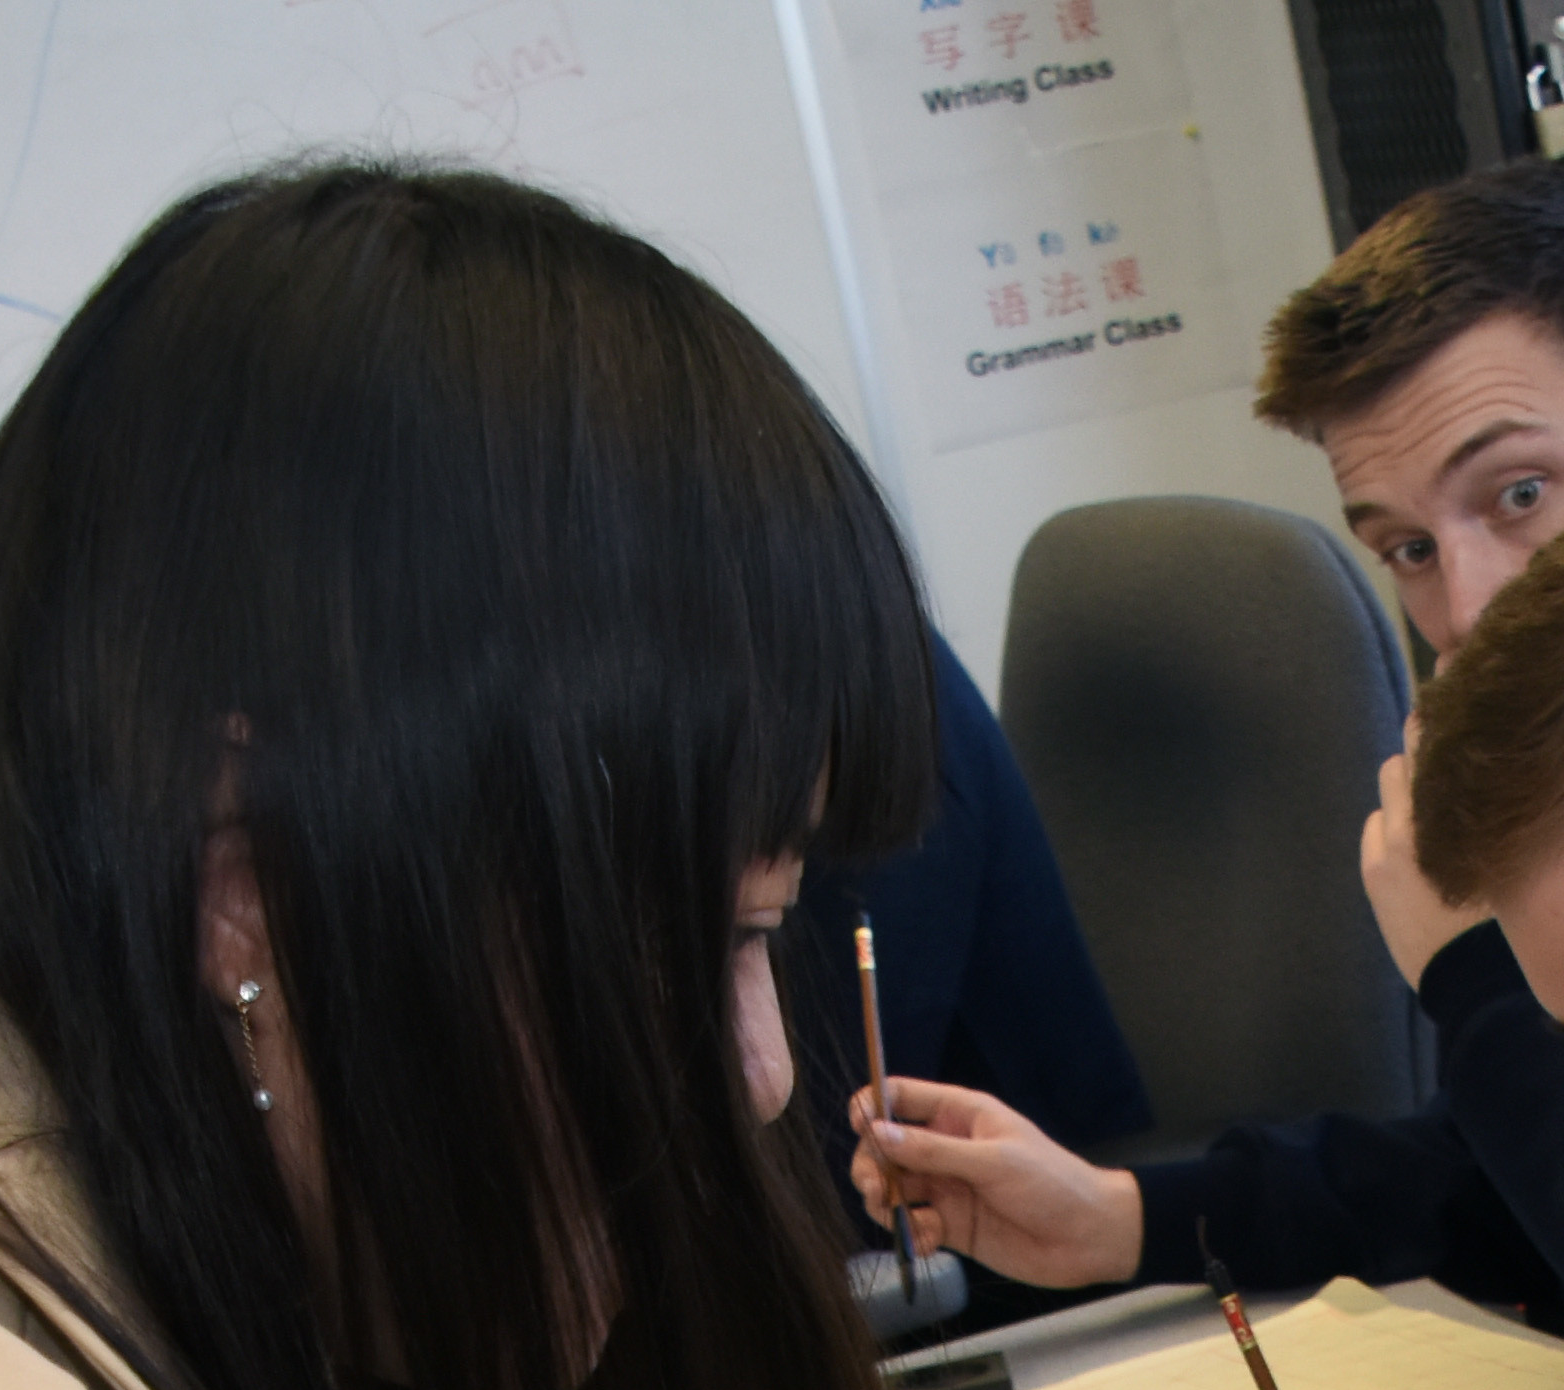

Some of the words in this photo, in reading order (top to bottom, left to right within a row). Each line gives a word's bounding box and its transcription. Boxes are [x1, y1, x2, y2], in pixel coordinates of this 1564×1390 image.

[922, 77, 1030, 115] Writing
[1035, 59, 1115, 92] Class
[967, 331, 1096, 377] Grammar
[1104, 312, 1184, 346] Class
